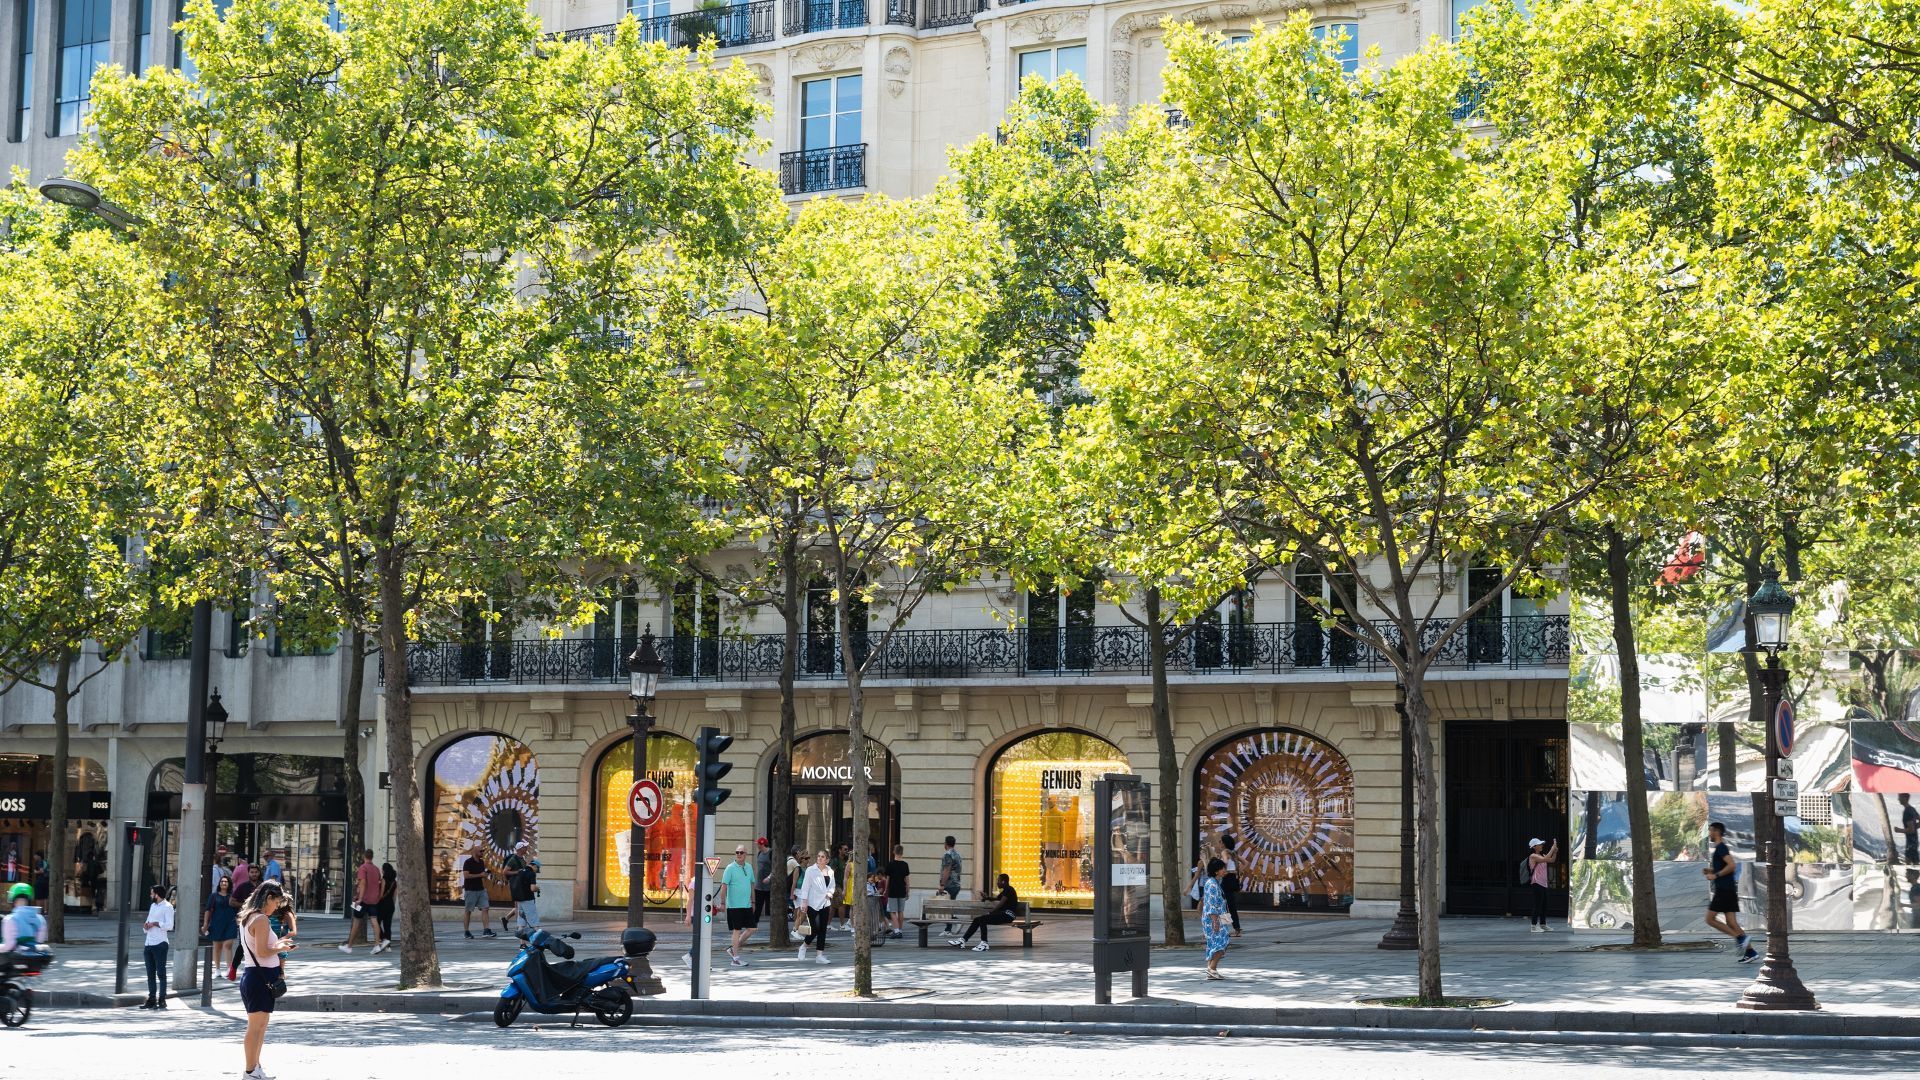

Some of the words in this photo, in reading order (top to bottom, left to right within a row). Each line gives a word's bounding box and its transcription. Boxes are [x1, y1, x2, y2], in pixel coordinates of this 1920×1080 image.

[802, 766, 873, 780] MONCLR
[1042, 770, 1082, 790] GENIUS
[0, 798, 26, 812] OSS
[92, 801, 109, 809] BOSS
[1045, 850, 1067, 859] MONCLER
[1069, 850, 1081, 858] 1952
